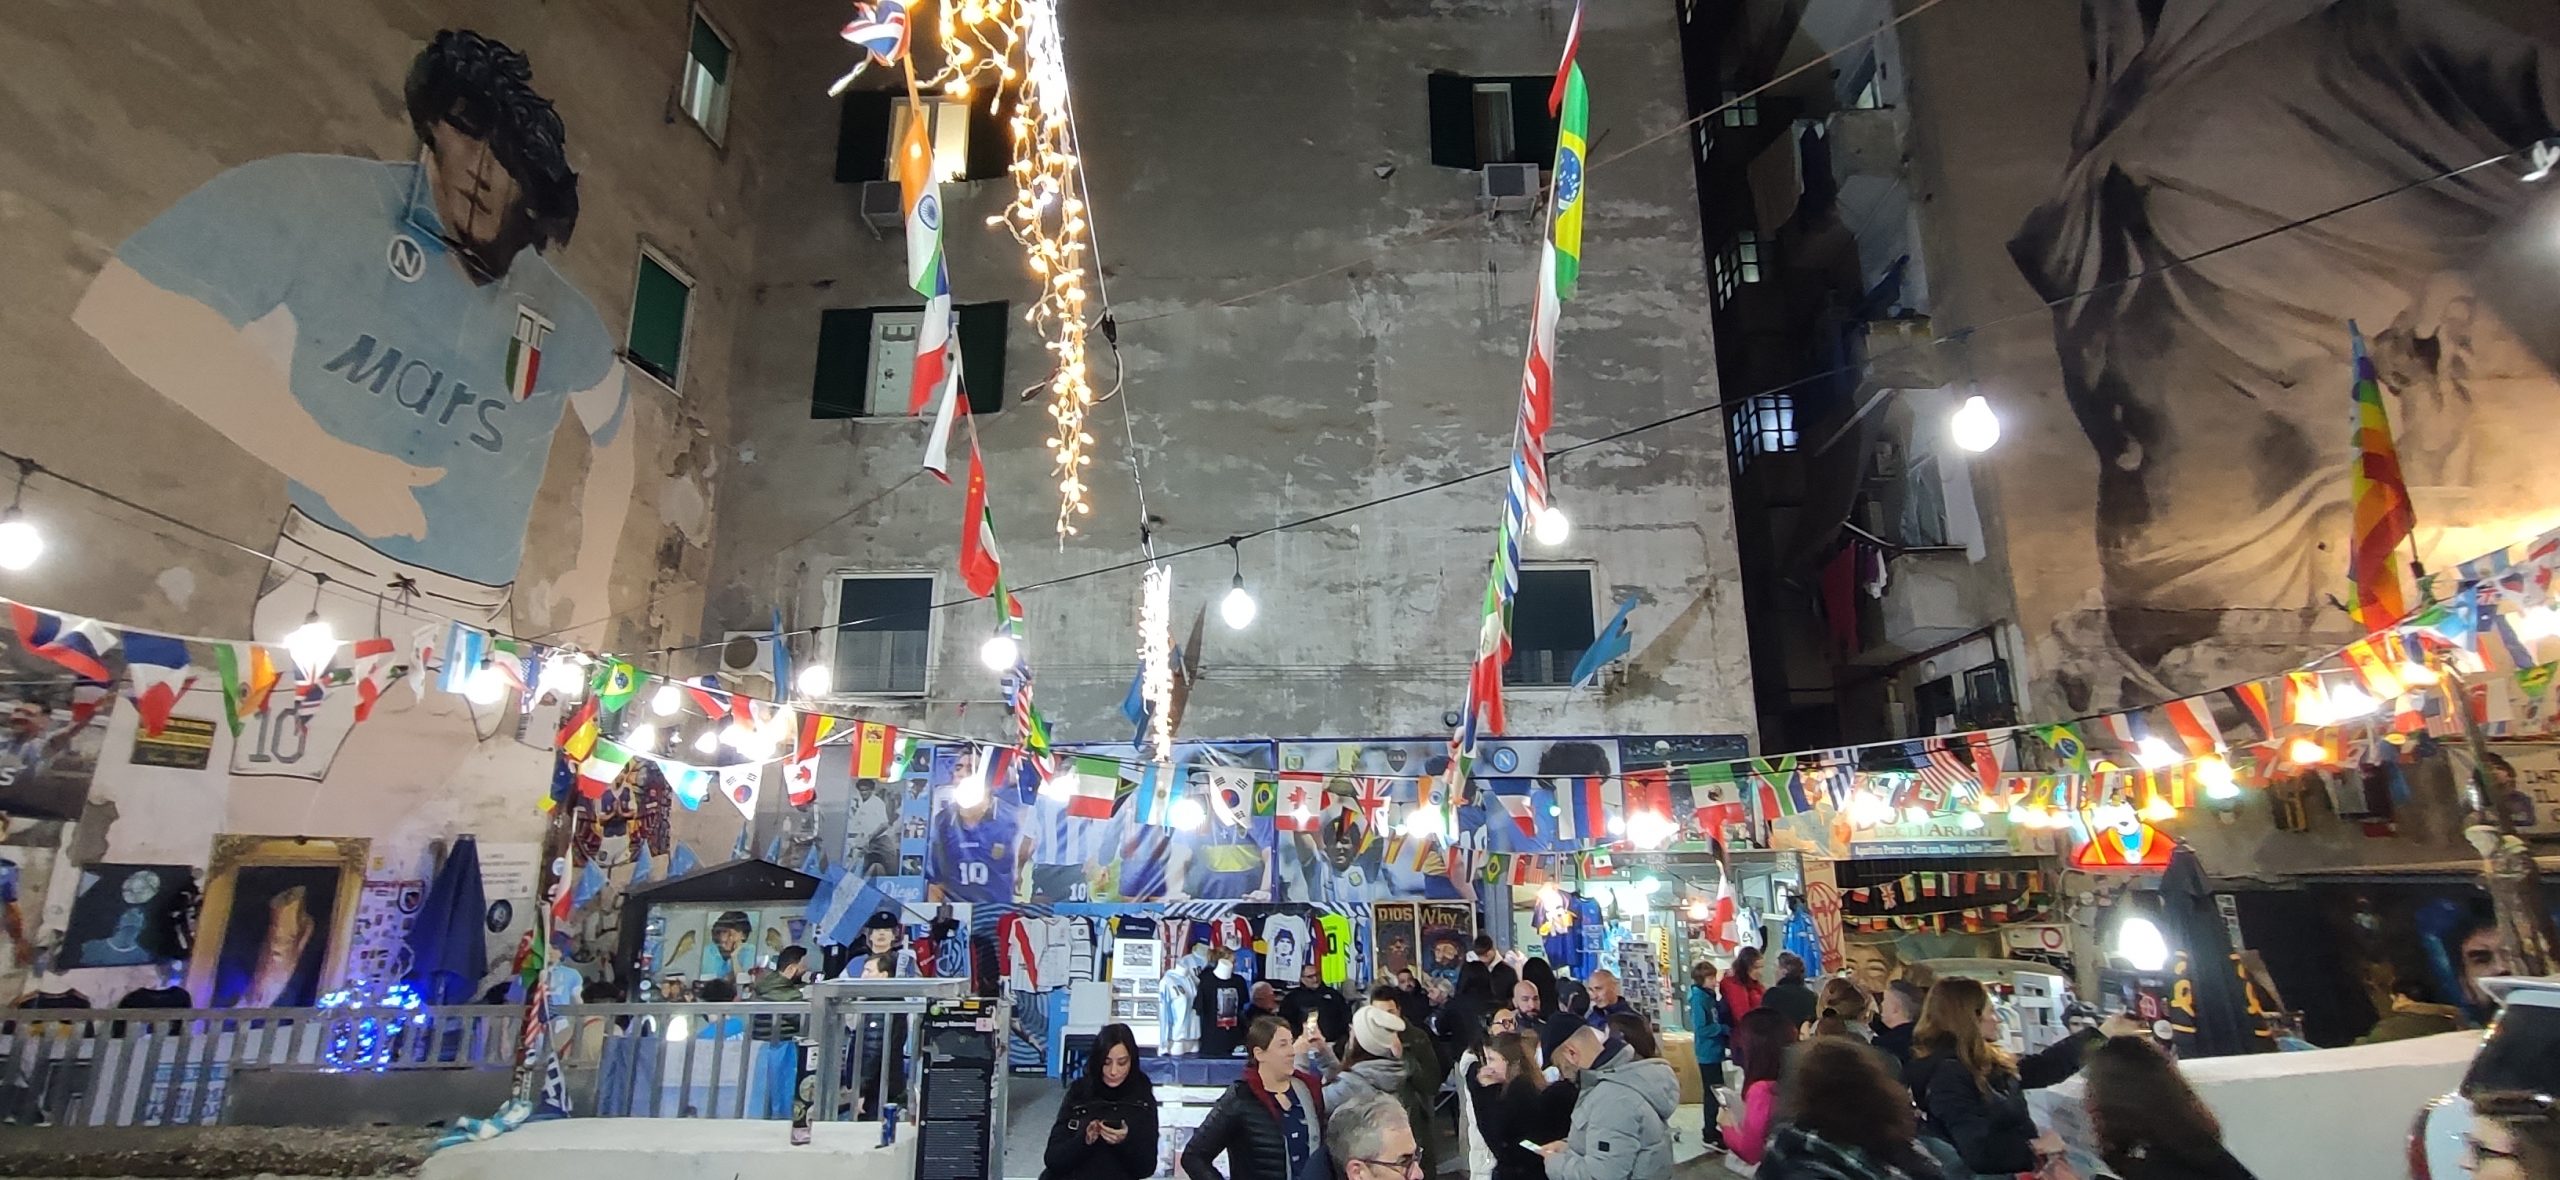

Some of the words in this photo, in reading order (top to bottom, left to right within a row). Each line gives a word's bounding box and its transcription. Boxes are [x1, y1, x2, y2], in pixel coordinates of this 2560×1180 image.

[322, 333, 508, 454] Mars
[248, 707, 308, 764] 10
[958, 862, 989, 885] 10
[1070, 883, 1087, 901] 10
[1420, 908, 1457, 930] Why
